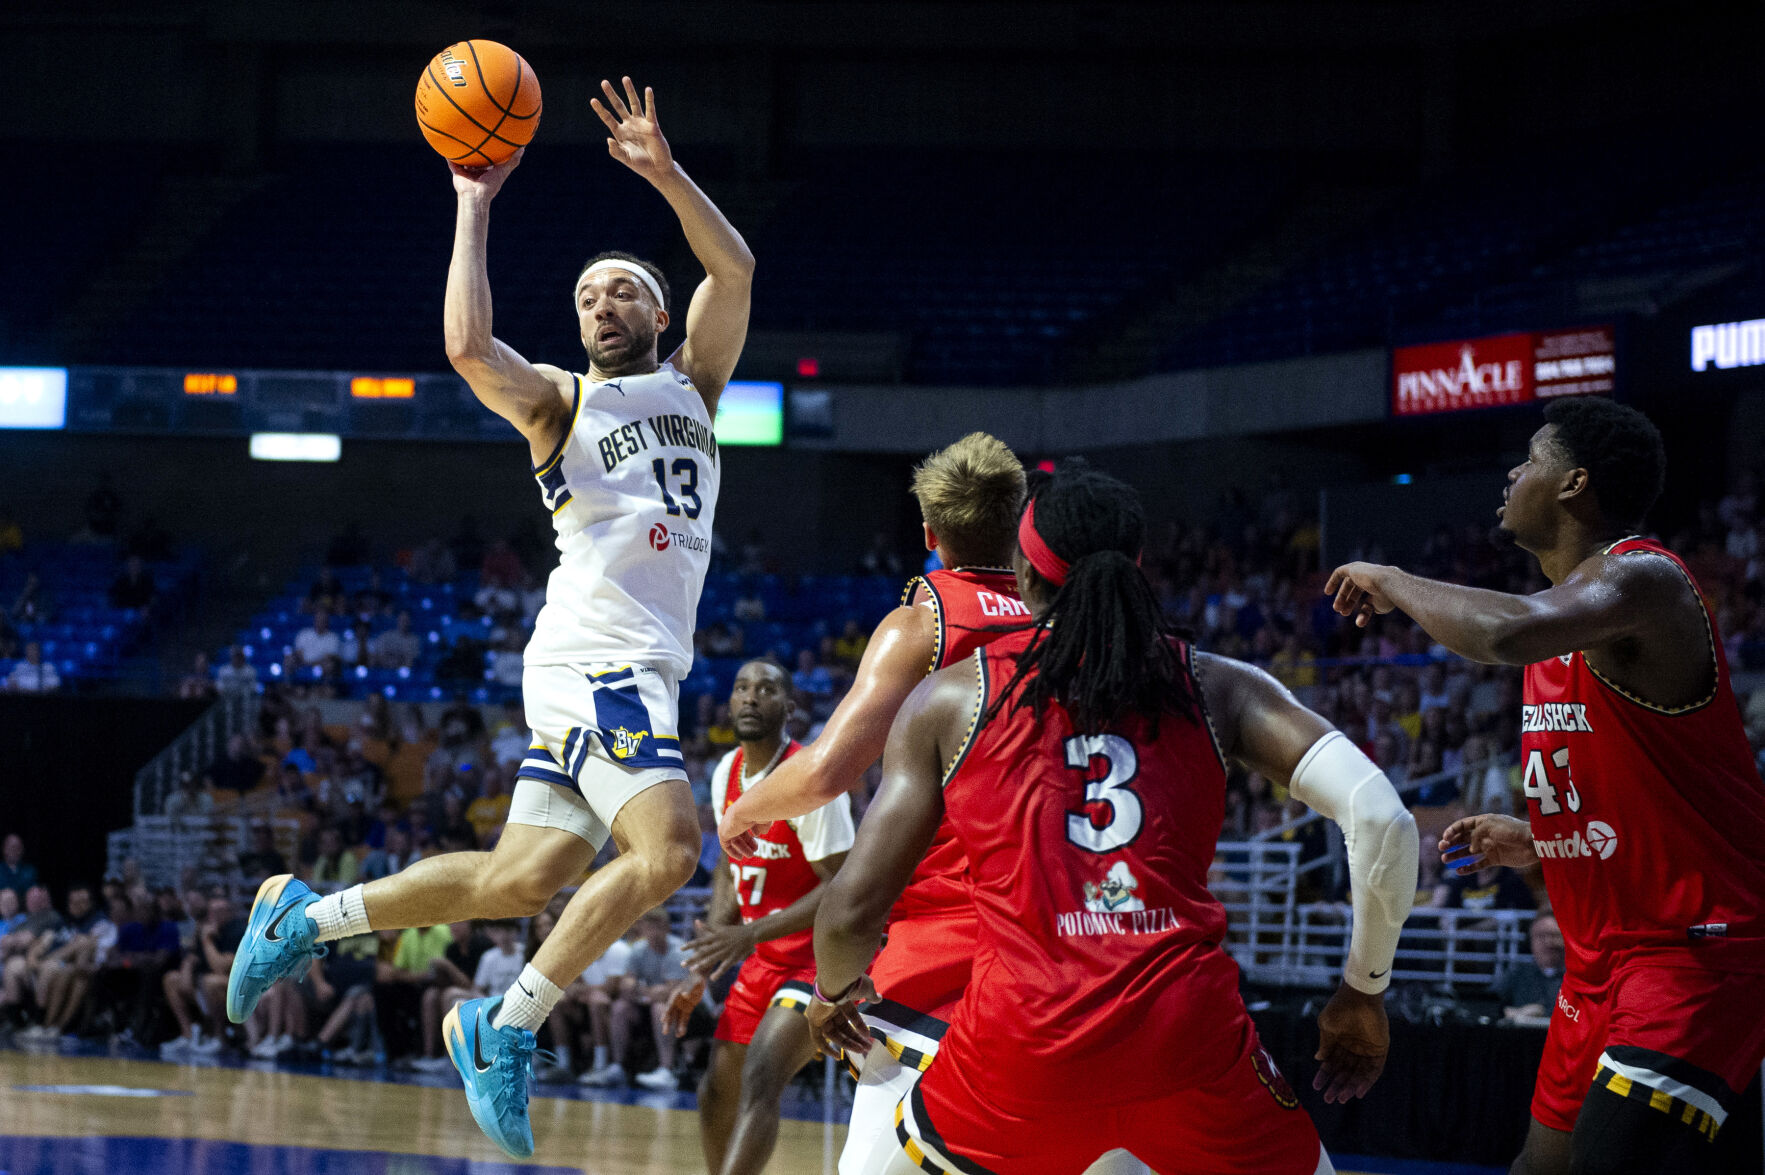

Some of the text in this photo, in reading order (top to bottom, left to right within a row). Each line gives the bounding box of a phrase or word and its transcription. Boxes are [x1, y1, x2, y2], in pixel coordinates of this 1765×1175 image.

[1398, 343, 1522, 402] PINNACLE
[598, 420, 648, 474] BEST
[652, 458, 702, 519] 13
[670, 532, 709, 553] TRILOGY
[1062, 733, 1145, 855] 3
[1056, 906, 1181, 937] POTOMAC PIZZA
